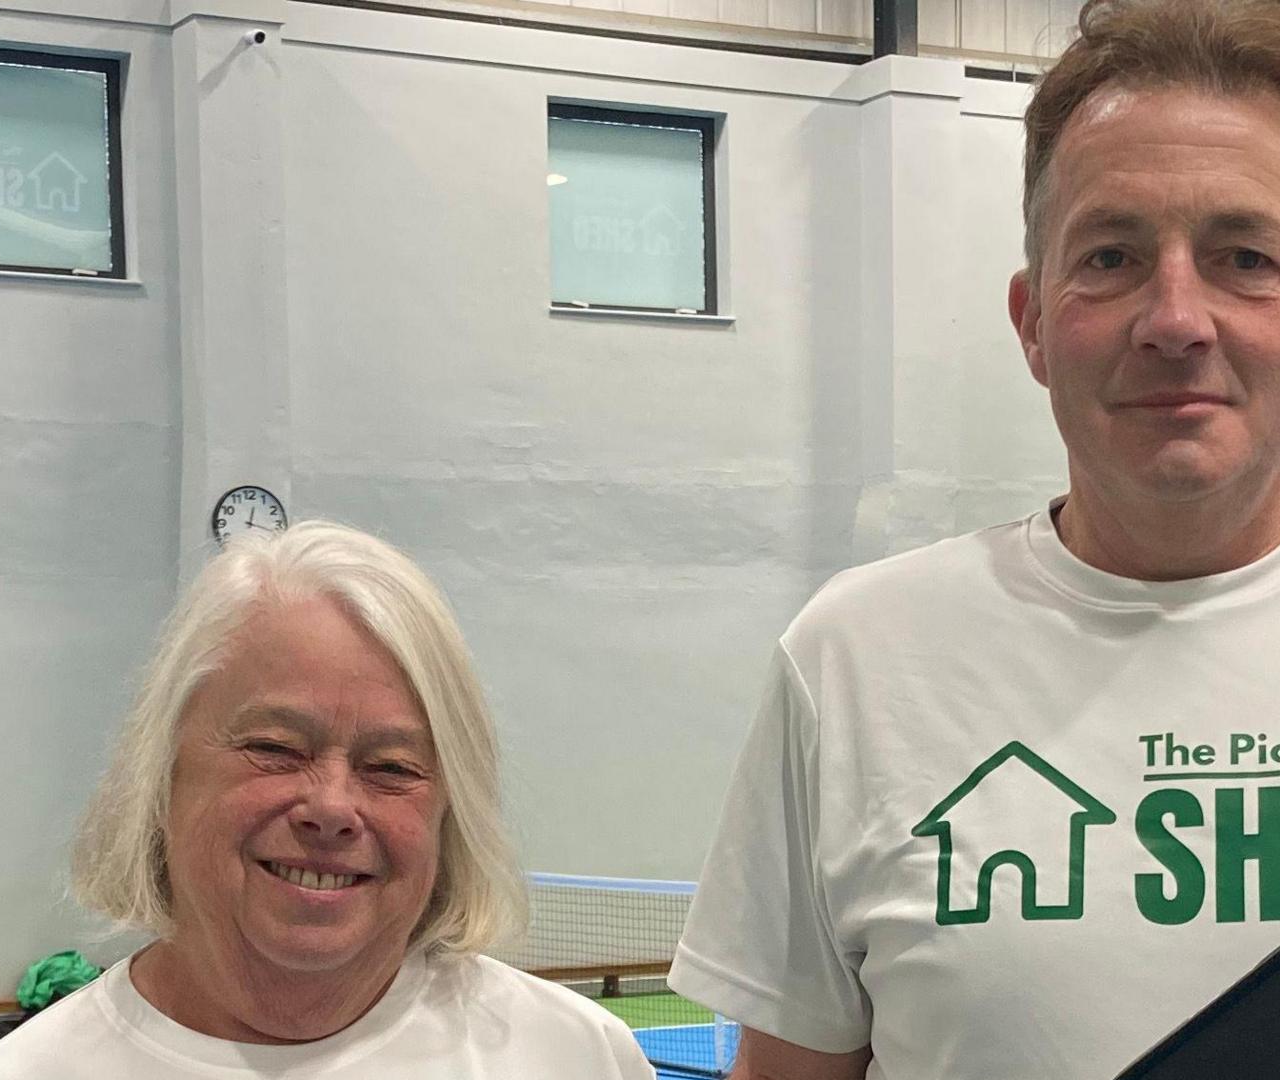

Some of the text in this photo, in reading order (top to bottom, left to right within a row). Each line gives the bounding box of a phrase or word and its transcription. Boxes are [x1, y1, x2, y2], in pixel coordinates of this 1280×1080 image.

[231, 493, 243, 504] 11
[242, 489, 257, 500] 12
[221, 505, 236, 516] 10
[269, 505, 280, 516] 2
[1139, 733, 1216, 769] The
